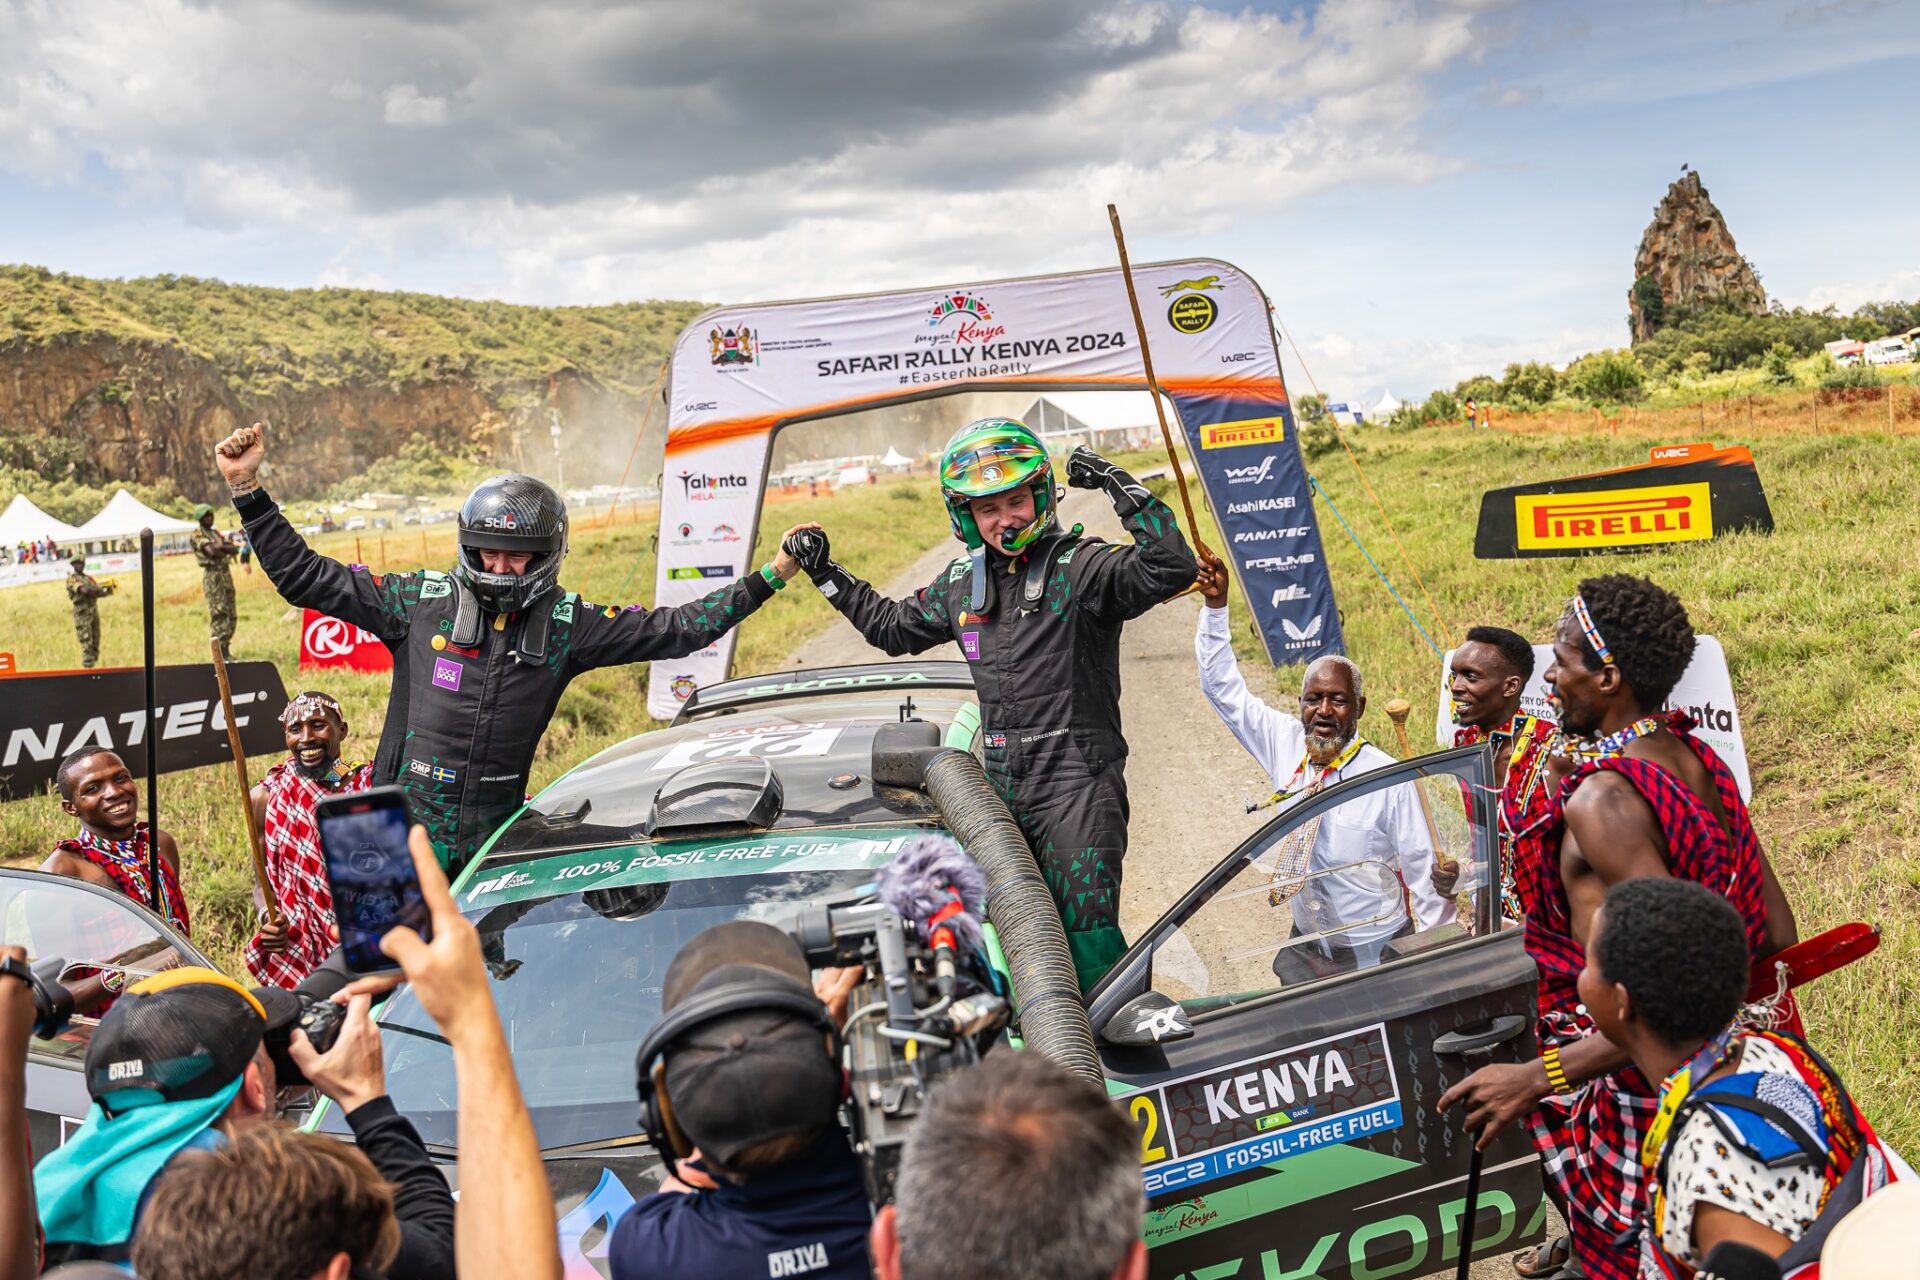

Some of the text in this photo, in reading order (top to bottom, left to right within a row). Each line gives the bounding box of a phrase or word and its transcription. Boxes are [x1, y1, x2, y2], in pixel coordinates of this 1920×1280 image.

[1179, 302, 1206, 310] SAFARI
[1181, 318, 1204, 326] RALLY
[956, 320, 1006, 345] Kenya
[817, 331, 1126, 378] SAFARI RALLY KENYA 2024
[1221, 352, 1256, 363] WRC
[899, 362, 1031, 384] #EasterNaRally
[685, 401, 717, 412] WRC
[1209, 422, 1276, 444] PIRELLI
[1654, 447, 1689, 458] WRC
[484, 516, 517, 530] Stilo
[1533, 496, 1692, 538] PIRELLI
[1234, 527, 1310, 543] FANATEC
[410, 761, 431, 775] OMP
[553, 842, 840, 881] 100% FOSSIL-FREE FUEL
[1203, 1049, 1355, 1125] KENYA
[1292, 1108, 1310, 1118] BANK
[1225, 1122, 1344, 1169] FOSSIL-FREE
[1348, 1109, 1394, 1135] FUEL
[1179, 1210, 1219, 1231] Kenya
